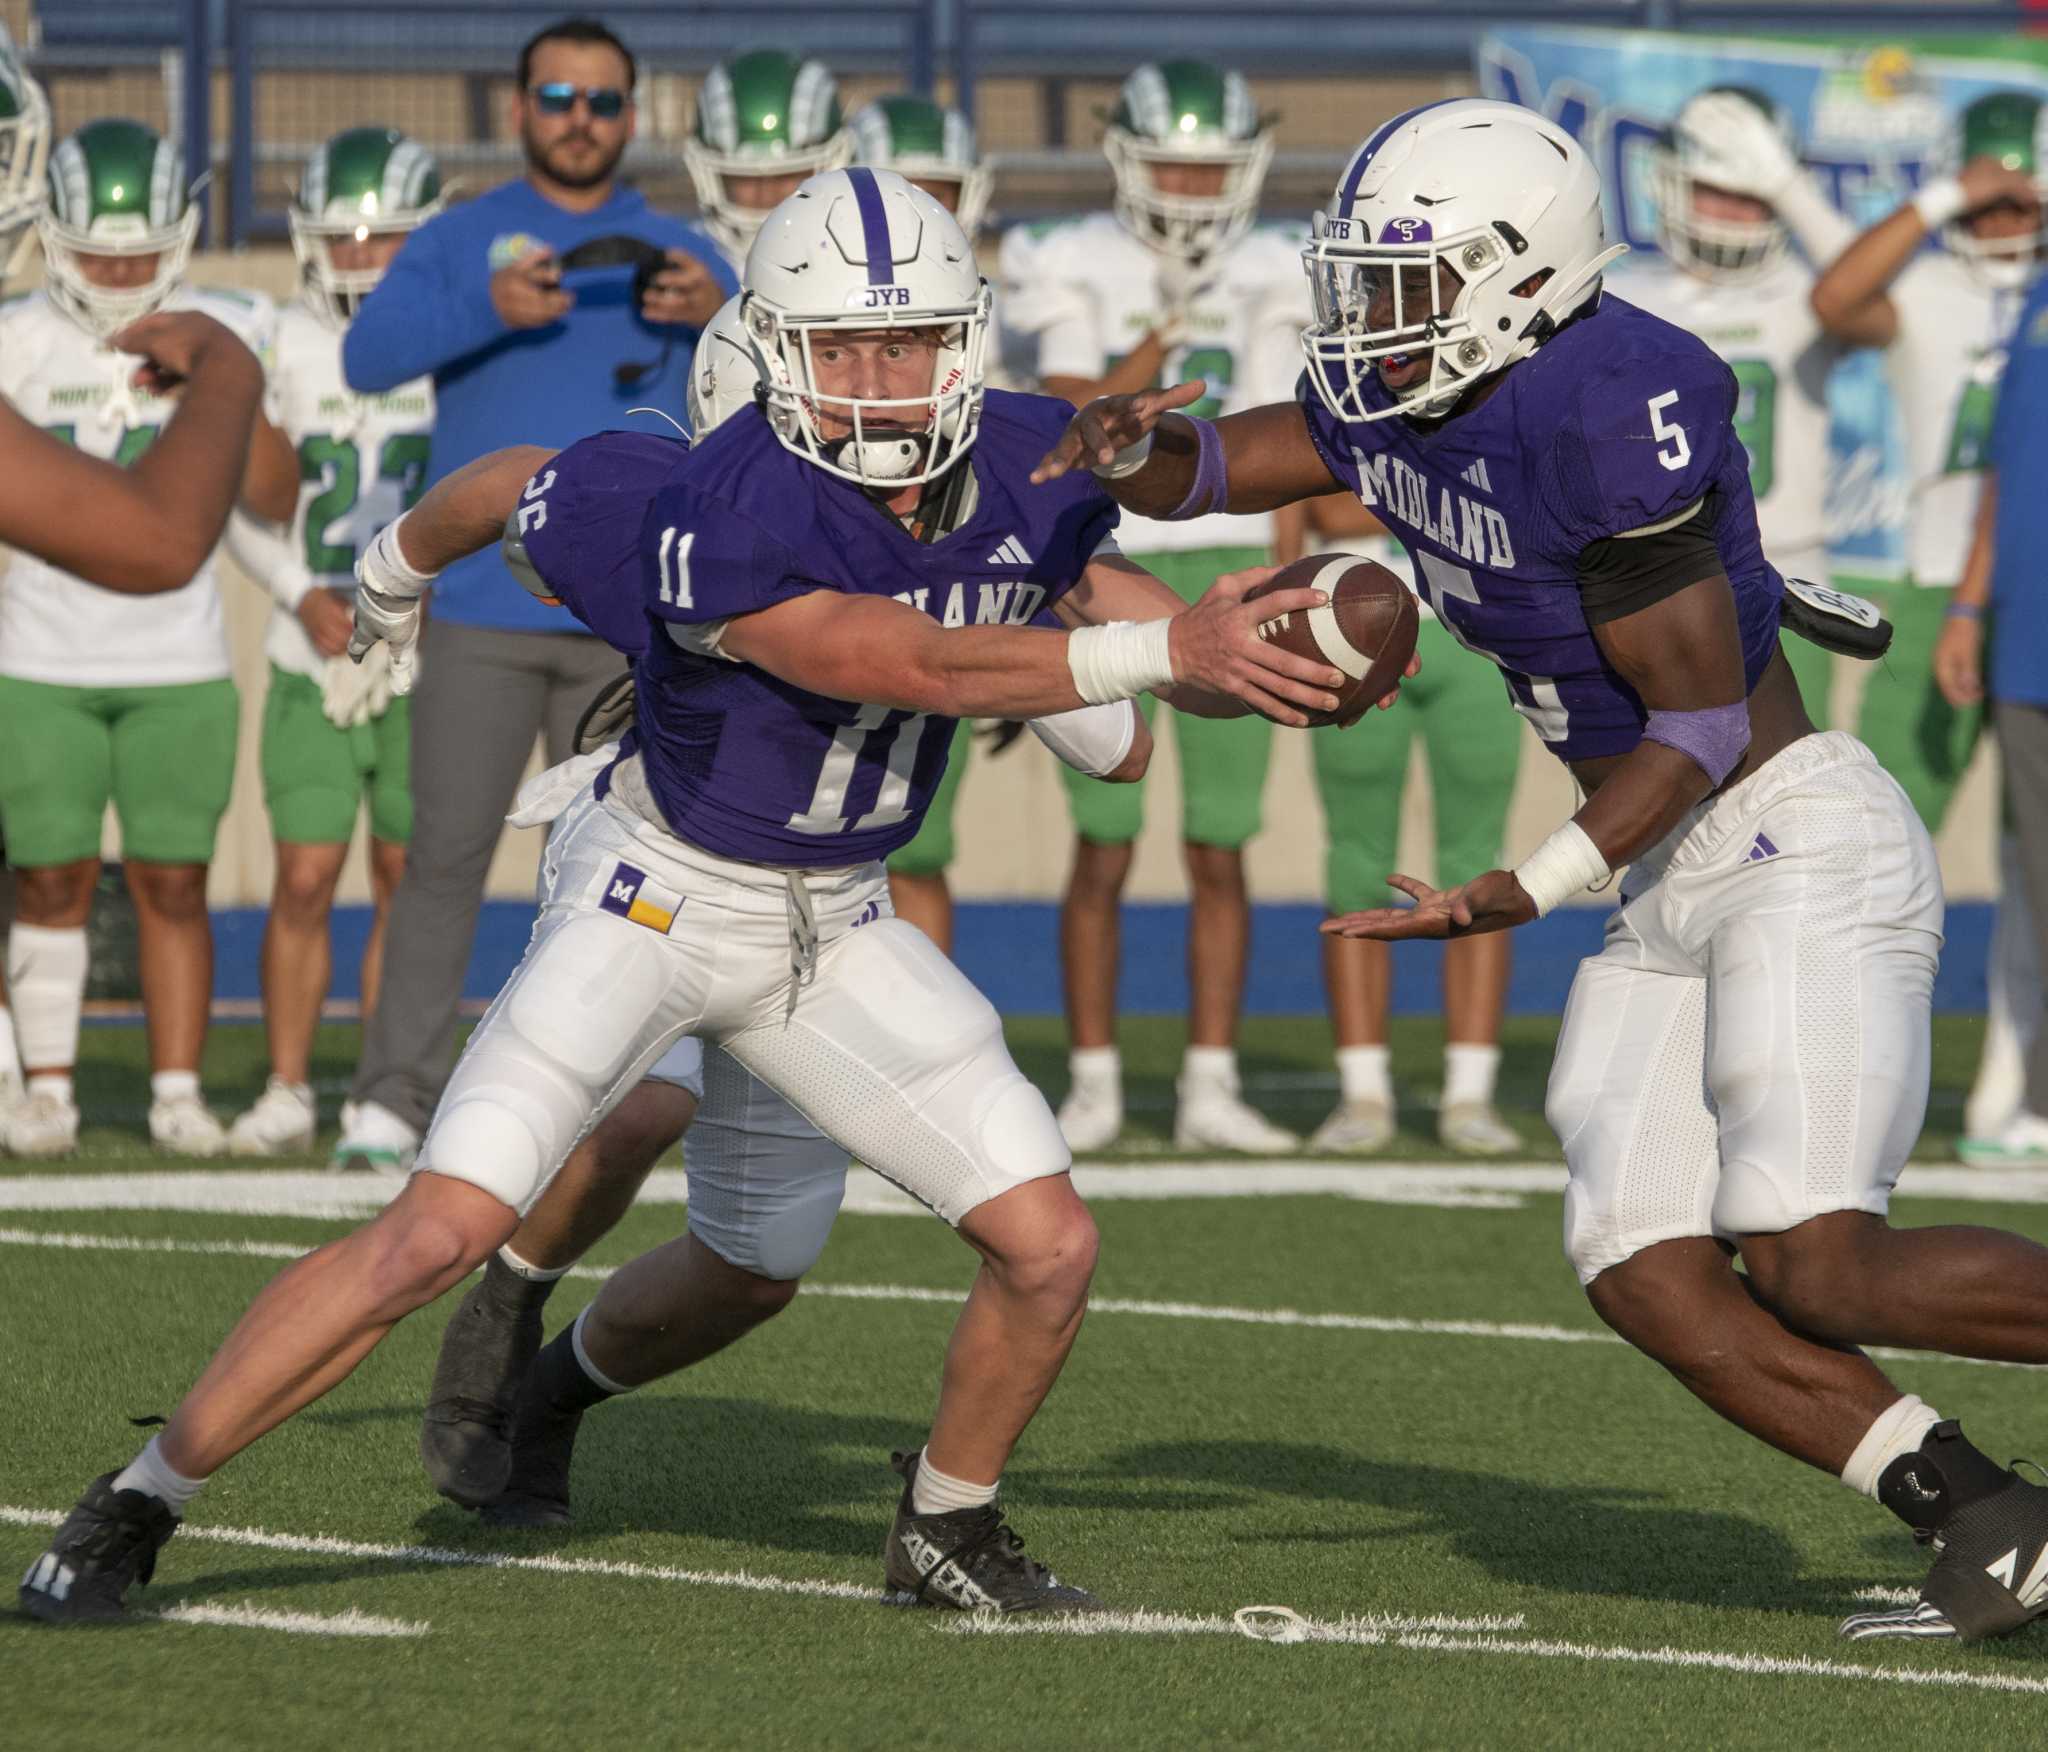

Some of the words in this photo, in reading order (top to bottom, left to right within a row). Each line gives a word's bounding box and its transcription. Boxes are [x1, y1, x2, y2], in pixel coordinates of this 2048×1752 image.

[865, 288, 910, 307] JYB
[1647, 389, 1692, 471] 5
[1350, 446, 1516, 569] MIDLAND
[659, 526, 695, 609] 11
[784, 704, 935, 836] 11
[609, 879, 636, 903] M
